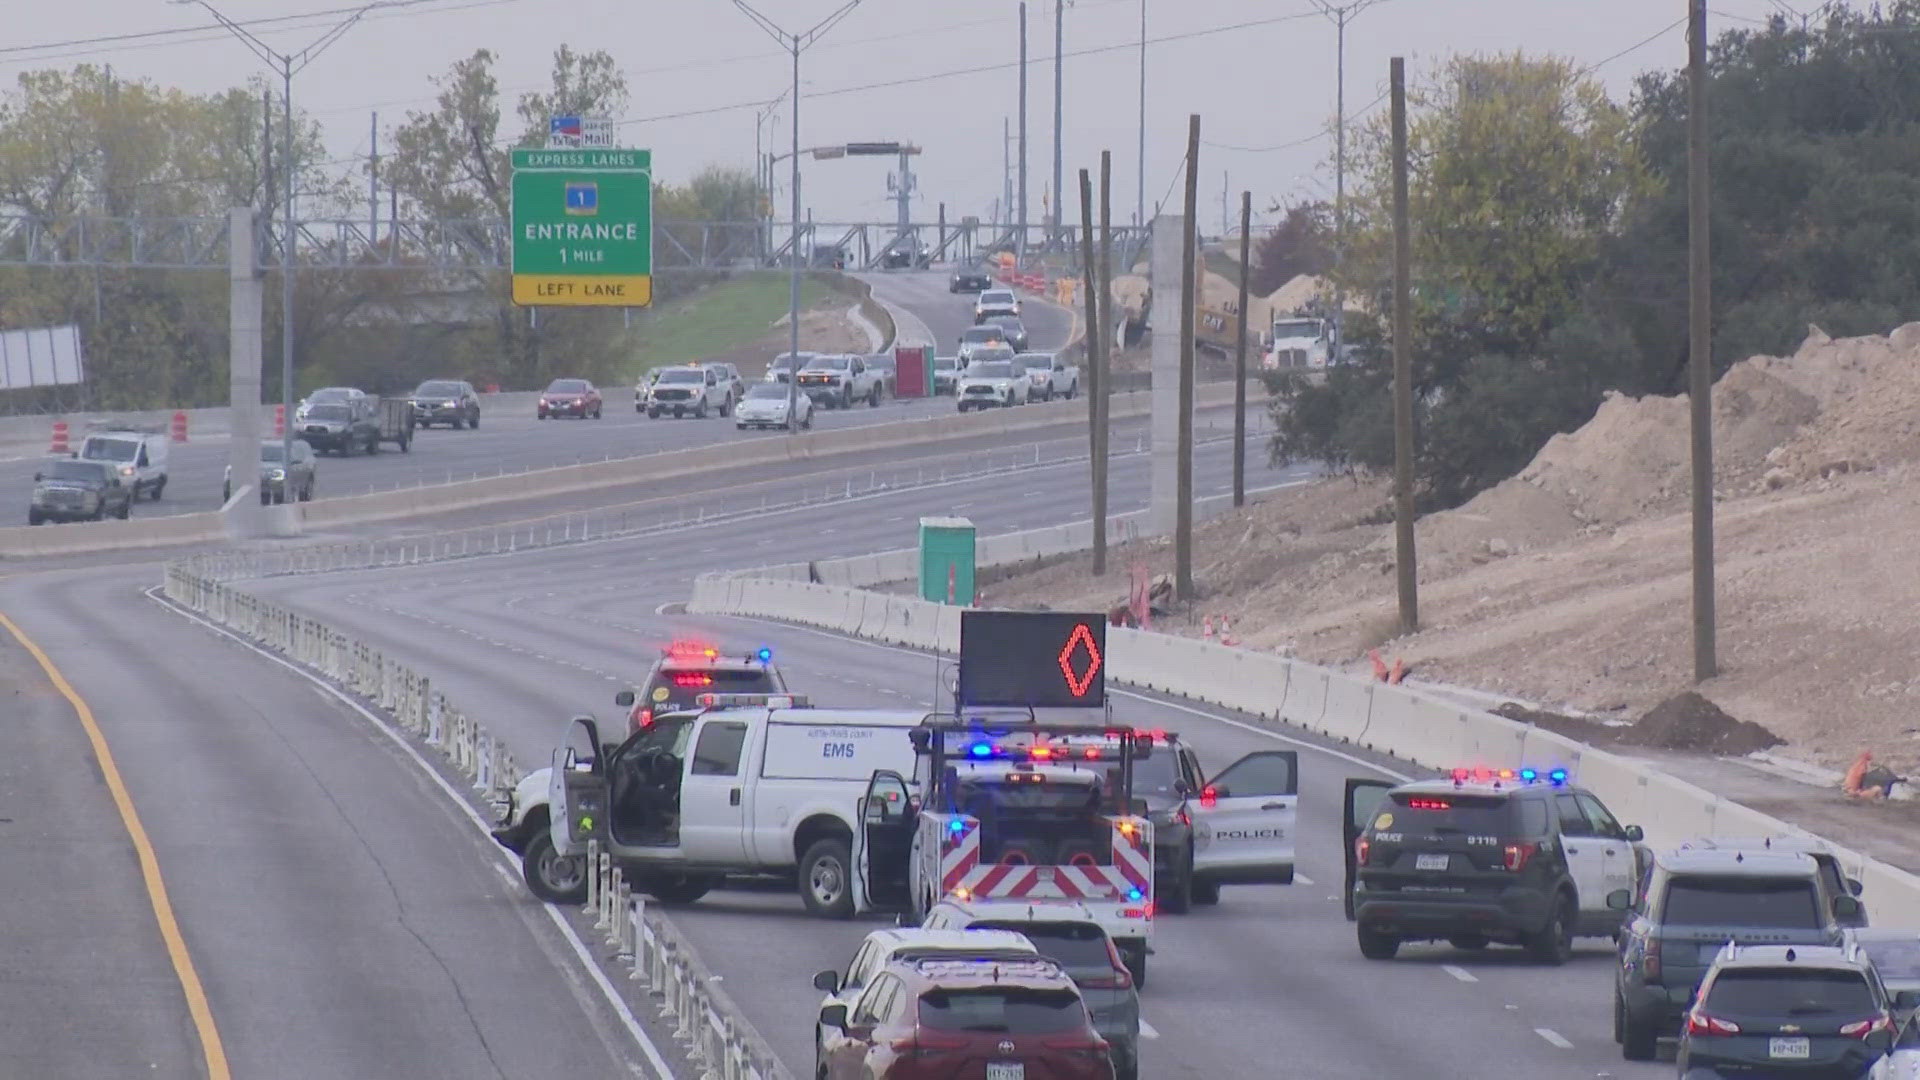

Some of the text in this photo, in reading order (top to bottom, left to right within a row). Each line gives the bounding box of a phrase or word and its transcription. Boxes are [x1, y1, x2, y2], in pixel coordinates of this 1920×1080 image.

[528, 154, 635, 166] EXPRESS LANES
[577, 191, 584, 206] 1
[525, 223, 637, 241] ENTRANCE
[560, 248, 604, 264] 1 MILE
[537, 283, 626, 296] LEFT LANE
[1202, 313, 1224, 331] CAT
[823, 743, 855, 758] EMS
[1216, 829, 1285, 839] POLICE
[1375, 833, 1403, 842] POLICE
